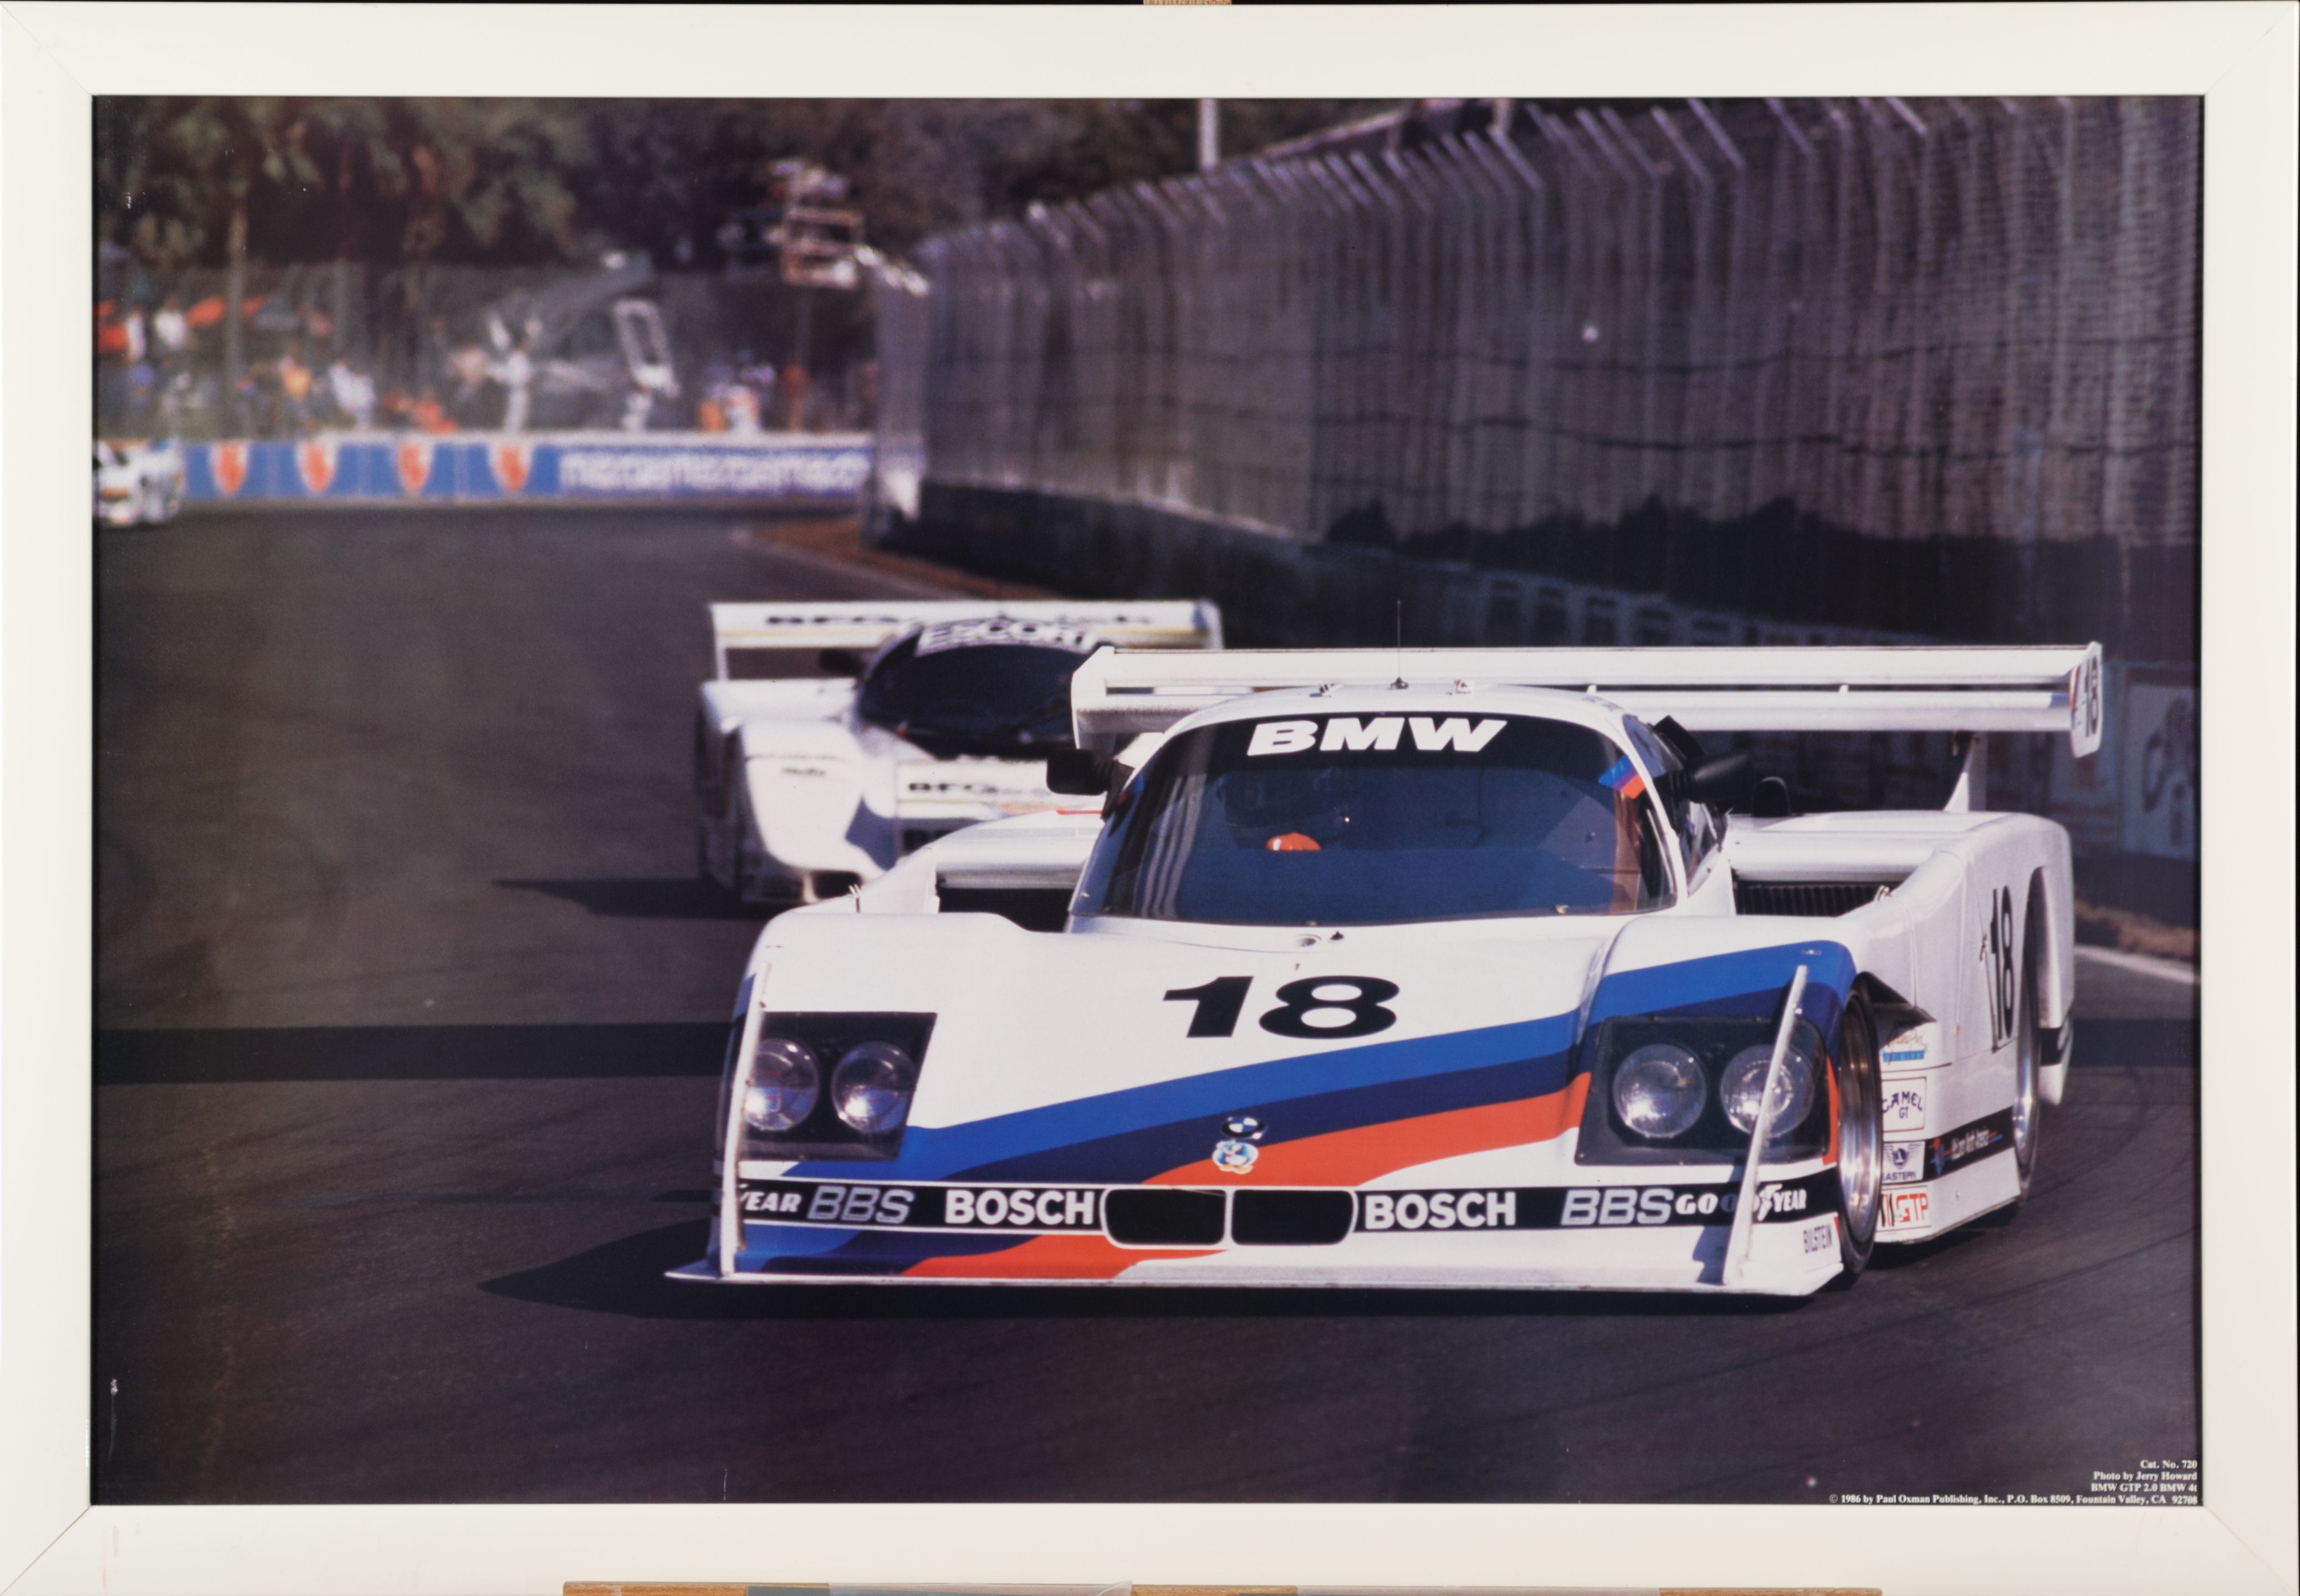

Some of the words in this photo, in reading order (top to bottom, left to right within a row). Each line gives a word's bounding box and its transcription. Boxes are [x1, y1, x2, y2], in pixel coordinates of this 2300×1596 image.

[2084, 655, 2099, 738] 18
[1247, 718, 1507, 756] BMW
[1990, 885, 2015, 1041] 18
[1163, 975, 1400, 1039] 18
[1899, 1107, 1909, 1119] GT
[807, 1185, 915, 1224] BBS
[944, 1189, 1095, 1225] BOSCH
[1364, 1191, 1516, 1230] BOSCH
[1560, 1189, 1674, 1226] BBS
[2093, 1471, 2121, 1480] Photo
[2123, 1471, 2134, 1482] by
[2135, 1471, 2159, 1482] Jerry
[2161, 1471, 2197, 1481] Howard
[2140, 1459, 2160, 1469] Cat.
[2162, 1459, 2179, 1469] No.
[2181, 1460, 2197, 1469] 720
[1841, 1494, 1862, 1503] 1986
[1863, 1495, 1874, 1505] by
[1876, 1494, 1897, 1503] Paul
[1898, 1494, 1930, 1503] Oxman
[1932, 1494, 1982, 1505] Publishing,
[1984, 1494, 2005, 1505] Inc.,
[2007, 1494, 2028, 1503] P.O.
[2030, 1494, 2048, 1503] Box
[2049, 1494, 2074, 1505] 8509,
[2076, 1495, 2117, 1504] Fountain
[2118, 1494, 2149, 1505] Valley,
[2150, 1495, 2167, 1504] CA
[2171, 1495, 2198, 1505] 92708
[2091, 1482, 2118, 1492] BMW
[2119, 1482, 2142, 1492] GTP
[2143, 1482, 2158, 1492] 2.0
[2159, 1482, 2187, 1492] BMW
